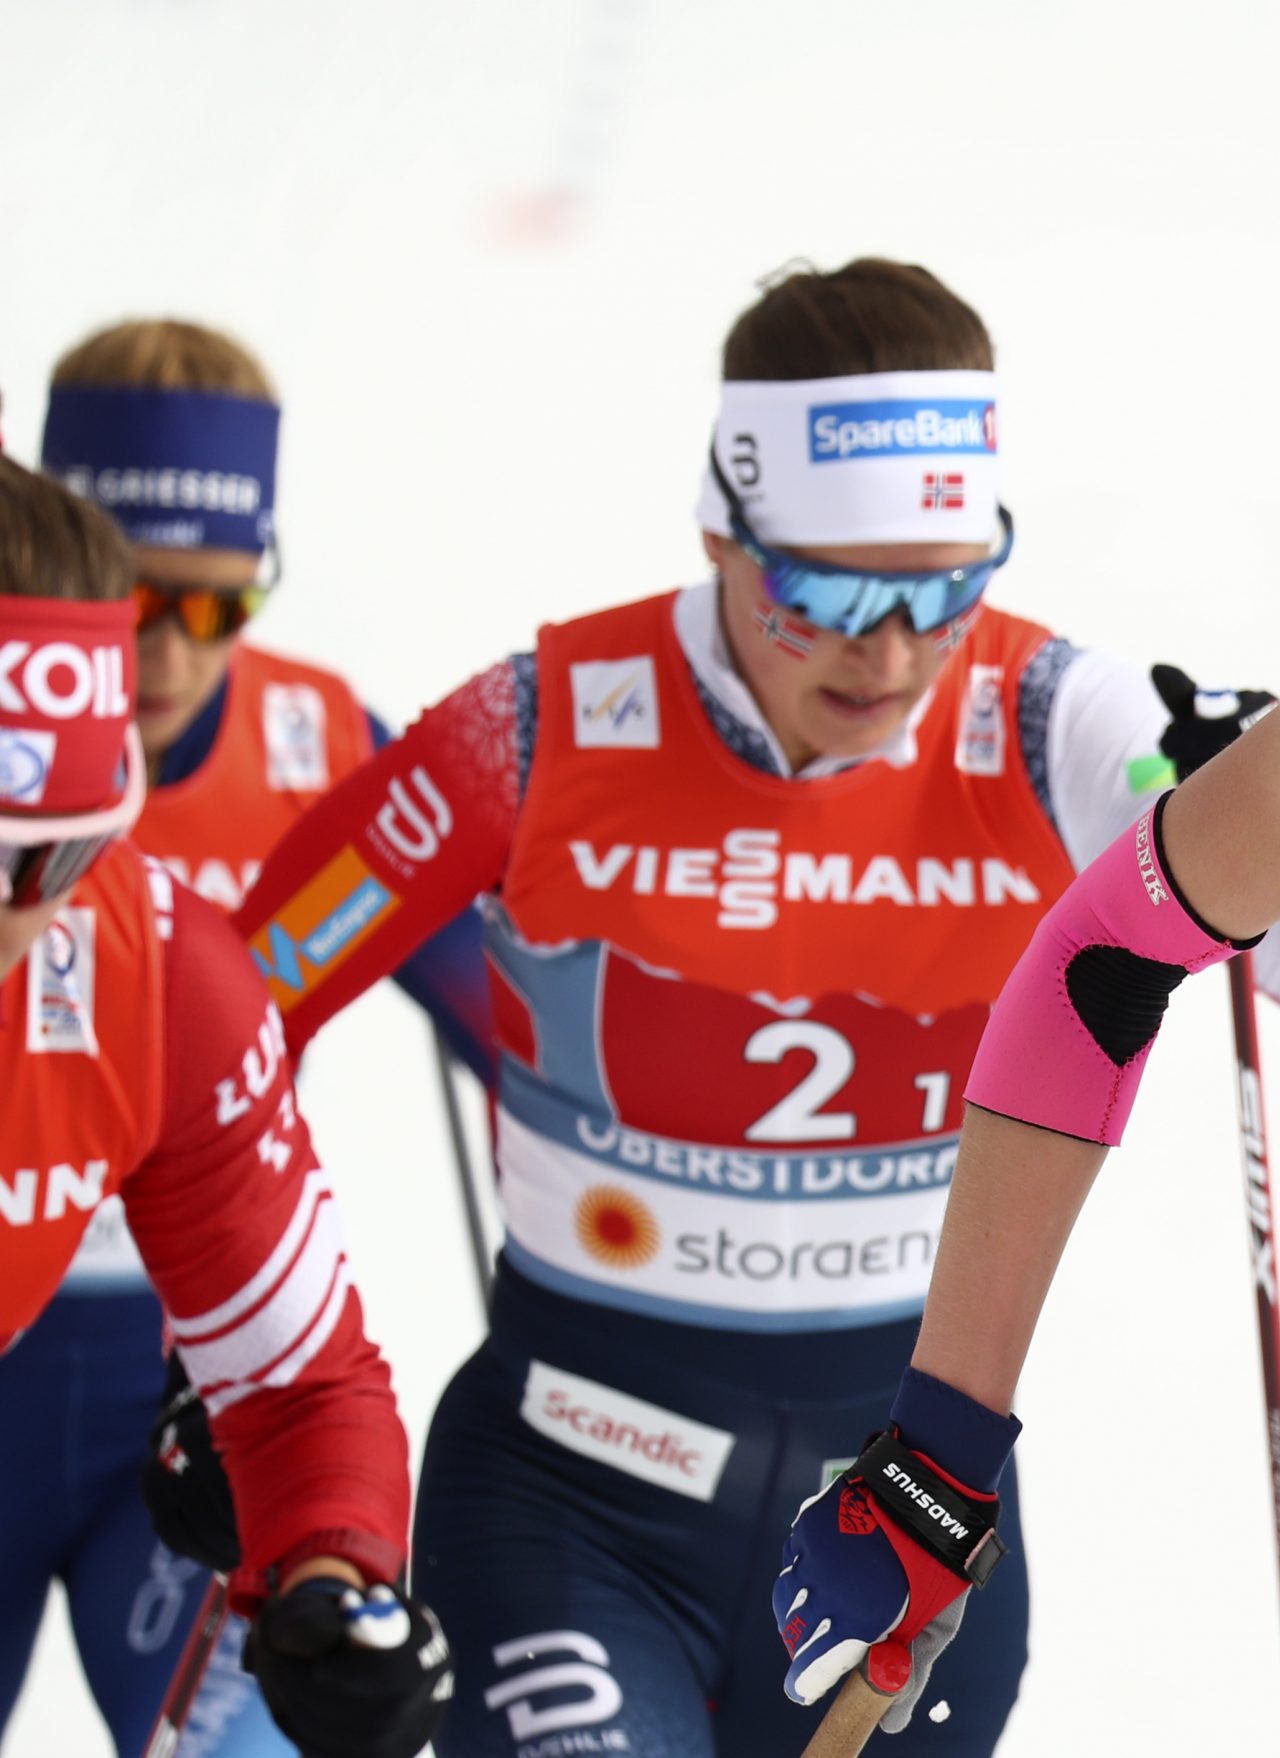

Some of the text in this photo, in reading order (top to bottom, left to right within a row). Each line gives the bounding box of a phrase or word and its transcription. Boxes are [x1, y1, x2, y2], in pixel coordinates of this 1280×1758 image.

[814, 408, 980, 458] SpareBank
[569, 828, 1041, 929] VIESSMANN
[744, 1018, 949, 1142] 2 1
[543, 1390, 703, 1478] Scandic
[882, 1462, 969, 1540] MADSHUS
